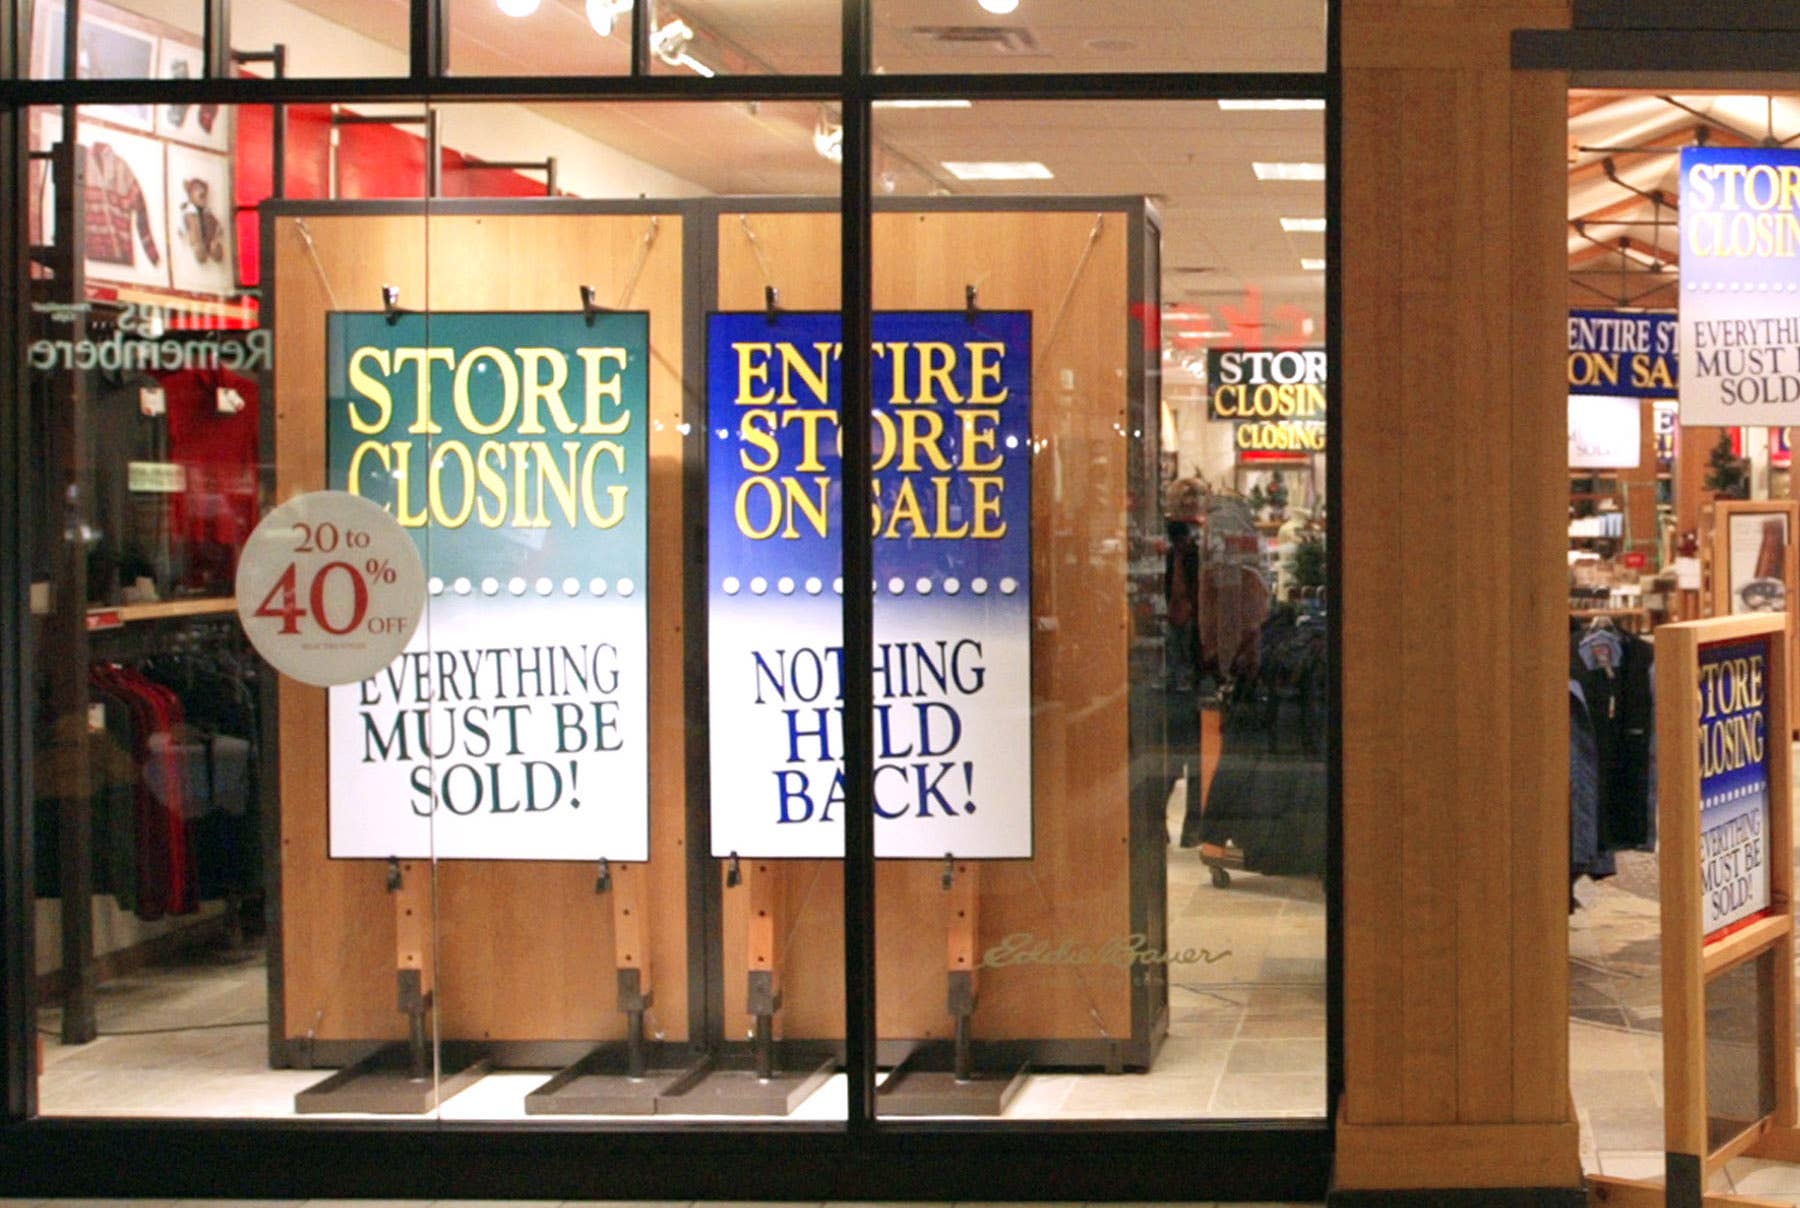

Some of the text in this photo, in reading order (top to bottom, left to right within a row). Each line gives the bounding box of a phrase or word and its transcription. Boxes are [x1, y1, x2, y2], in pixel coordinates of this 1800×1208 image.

[1568, 352, 1619, 385] ON
[1696, 347, 1785, 377] MUST
[349, 346, 631, 435] STORE
[1237, 424, 1326, 450] CLOSING
[348, 440, 629, 529] CLOSING
[734, 475, 832, 539] ON
[292, 522, 370, 552] 20 to
[367, 616, 407, 635] OFF
[359, 700, 624, 763] MUST BE
[410, 760, 581, 817] SOLD!
[1744, 837, 1760, 872] BE
